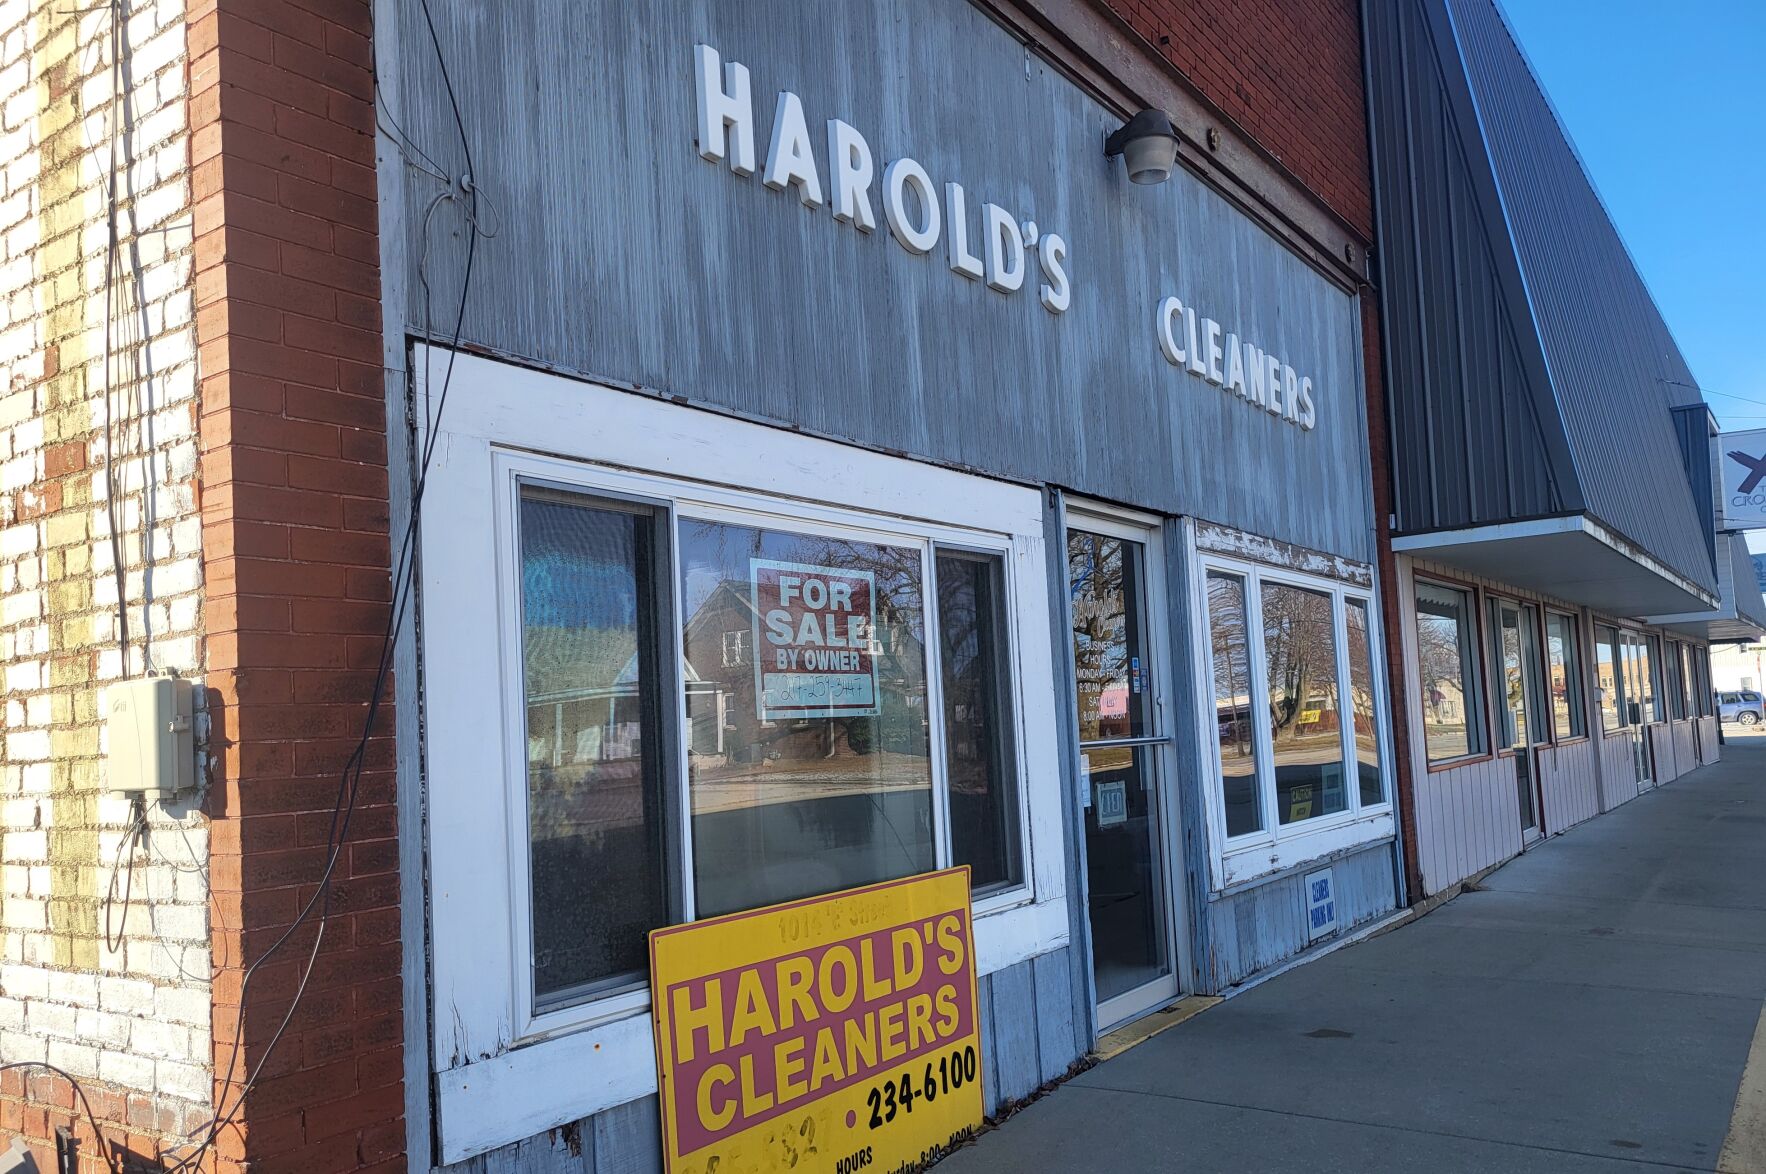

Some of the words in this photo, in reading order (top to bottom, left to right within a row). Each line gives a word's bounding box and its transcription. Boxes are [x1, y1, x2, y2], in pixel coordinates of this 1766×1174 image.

[694, 43, 1071, 314] HAROLD'S
[1156, 296, 1316, 432] CLEANERS
[779, 575, 853, 612] FOR
[765, 609, 867, 649] SALE
[1085, 640, 1115, 651] BUSINESS
[776, 648, 799, 670] BY
[804, 650, 861, 671] OWNER
[1089, 654, 1111, 665] HOURS
[672, 915, 965, 1065] HAROLD'S
[696, 984, 960, 1132] CLEANERS
[867, 1045, 976, 1130] 234-6100
[836, 1145, 873, 1174] HOURS
